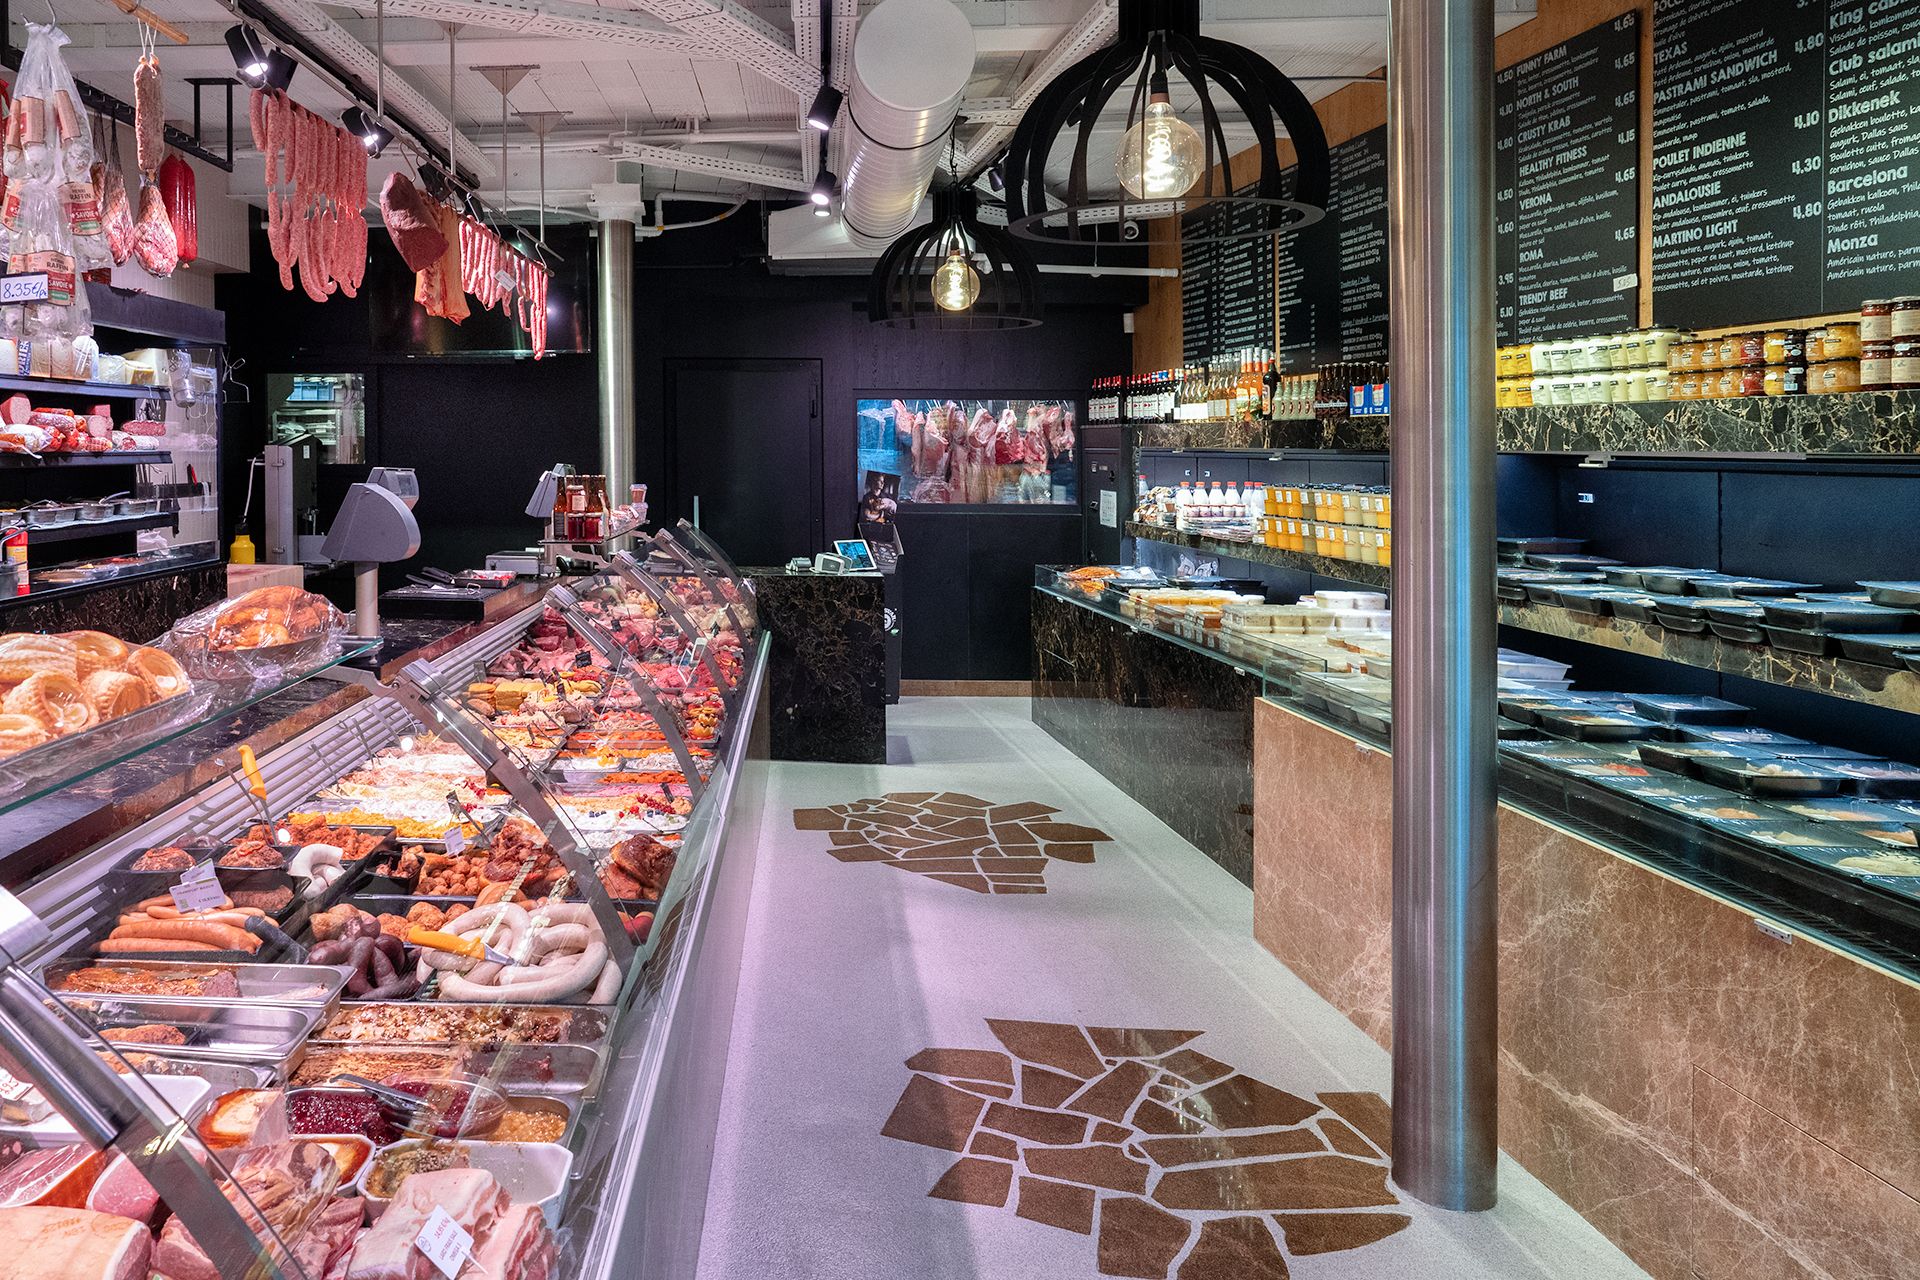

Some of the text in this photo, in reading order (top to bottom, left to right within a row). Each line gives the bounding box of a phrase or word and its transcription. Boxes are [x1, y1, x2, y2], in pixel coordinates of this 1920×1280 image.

[1830, 8, 1863, 30] King
[1736, 28, 1764, 45] mosterd
[1794, 32, 1824, 54] 4.80
[1829, 28, 1900, 56] Salade de poisson,
[1830, 24, 1868, 43] Vissalade,
[1516, 46, 1567, 77] FUNNY FARM
[1614, 52, 1635, 70] 4.65
[1654, 41, 1688, 65] TEXAS
[1828, 32, 1920, 76] Club salami
[1497, 70, 1514, 84] 4.50
[1654, 49, 1778, 104] PASTRAMI SANDWICH
[1690, 88, 1720, 106] pastrami,
[1720, 79, 1747, 93] tomaat,
[1761, 62, 1792, 80] mosterd,
[1830, 76, 1858, 90] Salami,
[1860, 70, 1868, 80] ei,
[1870, 60, 1905, 77] tomaat,
[1516, 92, 1542, 110] NORTH
[1544, 88, 1550, 99] &
[1552, 76, 1579, 96] SOUTH
[1615, 90, 1635, 108] 4.65
[1830, 87, 1858, 104] Salami,
[1880, 72, 1909, 88] salade,
[1690, 111, 1720, 128] pastrami,
[1720, 104, 1746, 116] tomate,
[1748, 94, 1770, 108] salade,
[1828, 90, 1900, 124] Dikkenek
[1517, 116, 1570, 143] CRUSTY KRAB
[1794, 110, 1820, 130] 4.10
[1830, 120, 1868, 138] Gebakken
[1870, 110, 1908, 125] boulette,
[1498, 137, 1514, 150] 4.80
[1618, 128, 1636, 144] 4.15
[1830, 122, 1908, 150] augurk, Dallas saus
[1520, 156, 1554, 177] HEALTHY
[1556, 146, 1587, 166] FITNESS
[1653, 131, 1746, 170] POULET INDIENNE
[1829, 147, 1865, 162] Boulette
[1866, 142, 1888, 153] cuite,
[1830, 146, 1920, 174] cornichon, sauce Dallas
[1615, 167, 1636, 183] 4.65
[1792, 156, 1822, 175] 4.30
[1652, 183, 1670, 192] Poulet
[1828, 166, 1908, 195] Barcelona
[1520, 192, 1552, 210] VERONA
[1652, 180, 1721, 210] ANDALOUSIE
[1828, 194, 1866, 210] Gebakken
[1868, 188, 1900, 200] kalkoen,
[1652, 222, 1670, 232] Poulet
[1702, 208, 1734, 221] concombre,
[1792, 201, 1822, 220] 4.80
[1828, 202, 1885, 220] tomaat, rucola
[1498, 222, 1514, 236] 4.60
[1615, 226, 1636, 241] 4.65
[1652, 219, 1738, 249] MARTINO LIGHT
[1827, 223, 1848, 234] Dinde
[1850, 218, 1868, 230] rôti,
[1680, 246, 1702, 254] nature,
[1703, 240, 1726, 252] augurk,
[1746, 231, 1774, 242] tomaat,
[1691, 255, 1708, 266] peper
[1718, 250, 1735, 260] zout,
[1736, 243, 1765, 256] mosterd,
[1766, 240, 1794, 250] ketchup
[1827, 234, 1878, 254] Monza
[1520, 248, 1544, 263] ROMA
[1680, 268, 1702, 277] nature,
[1752, 254, 1780, 264] tomate,
[1827, 254, 1864, 268] Américain
[1866, 248, 1896, 260] nature,
[1498, 273, 1514, 286] 3.95
[1691, 278, 1699, 286] sel
[1710, 274, 1730, 285] poivre,
[1732, 267, 1764, 280] moutarde,
[1766, 264, 1794, 275] ketchup
[1827, 267, 1864, 281] Américain
[1866, 262, 1896, 274] nature,
[1519, 288, 1569, 306] TRENDY BEEF
[1500, 306, 1514, 318] 5.10
